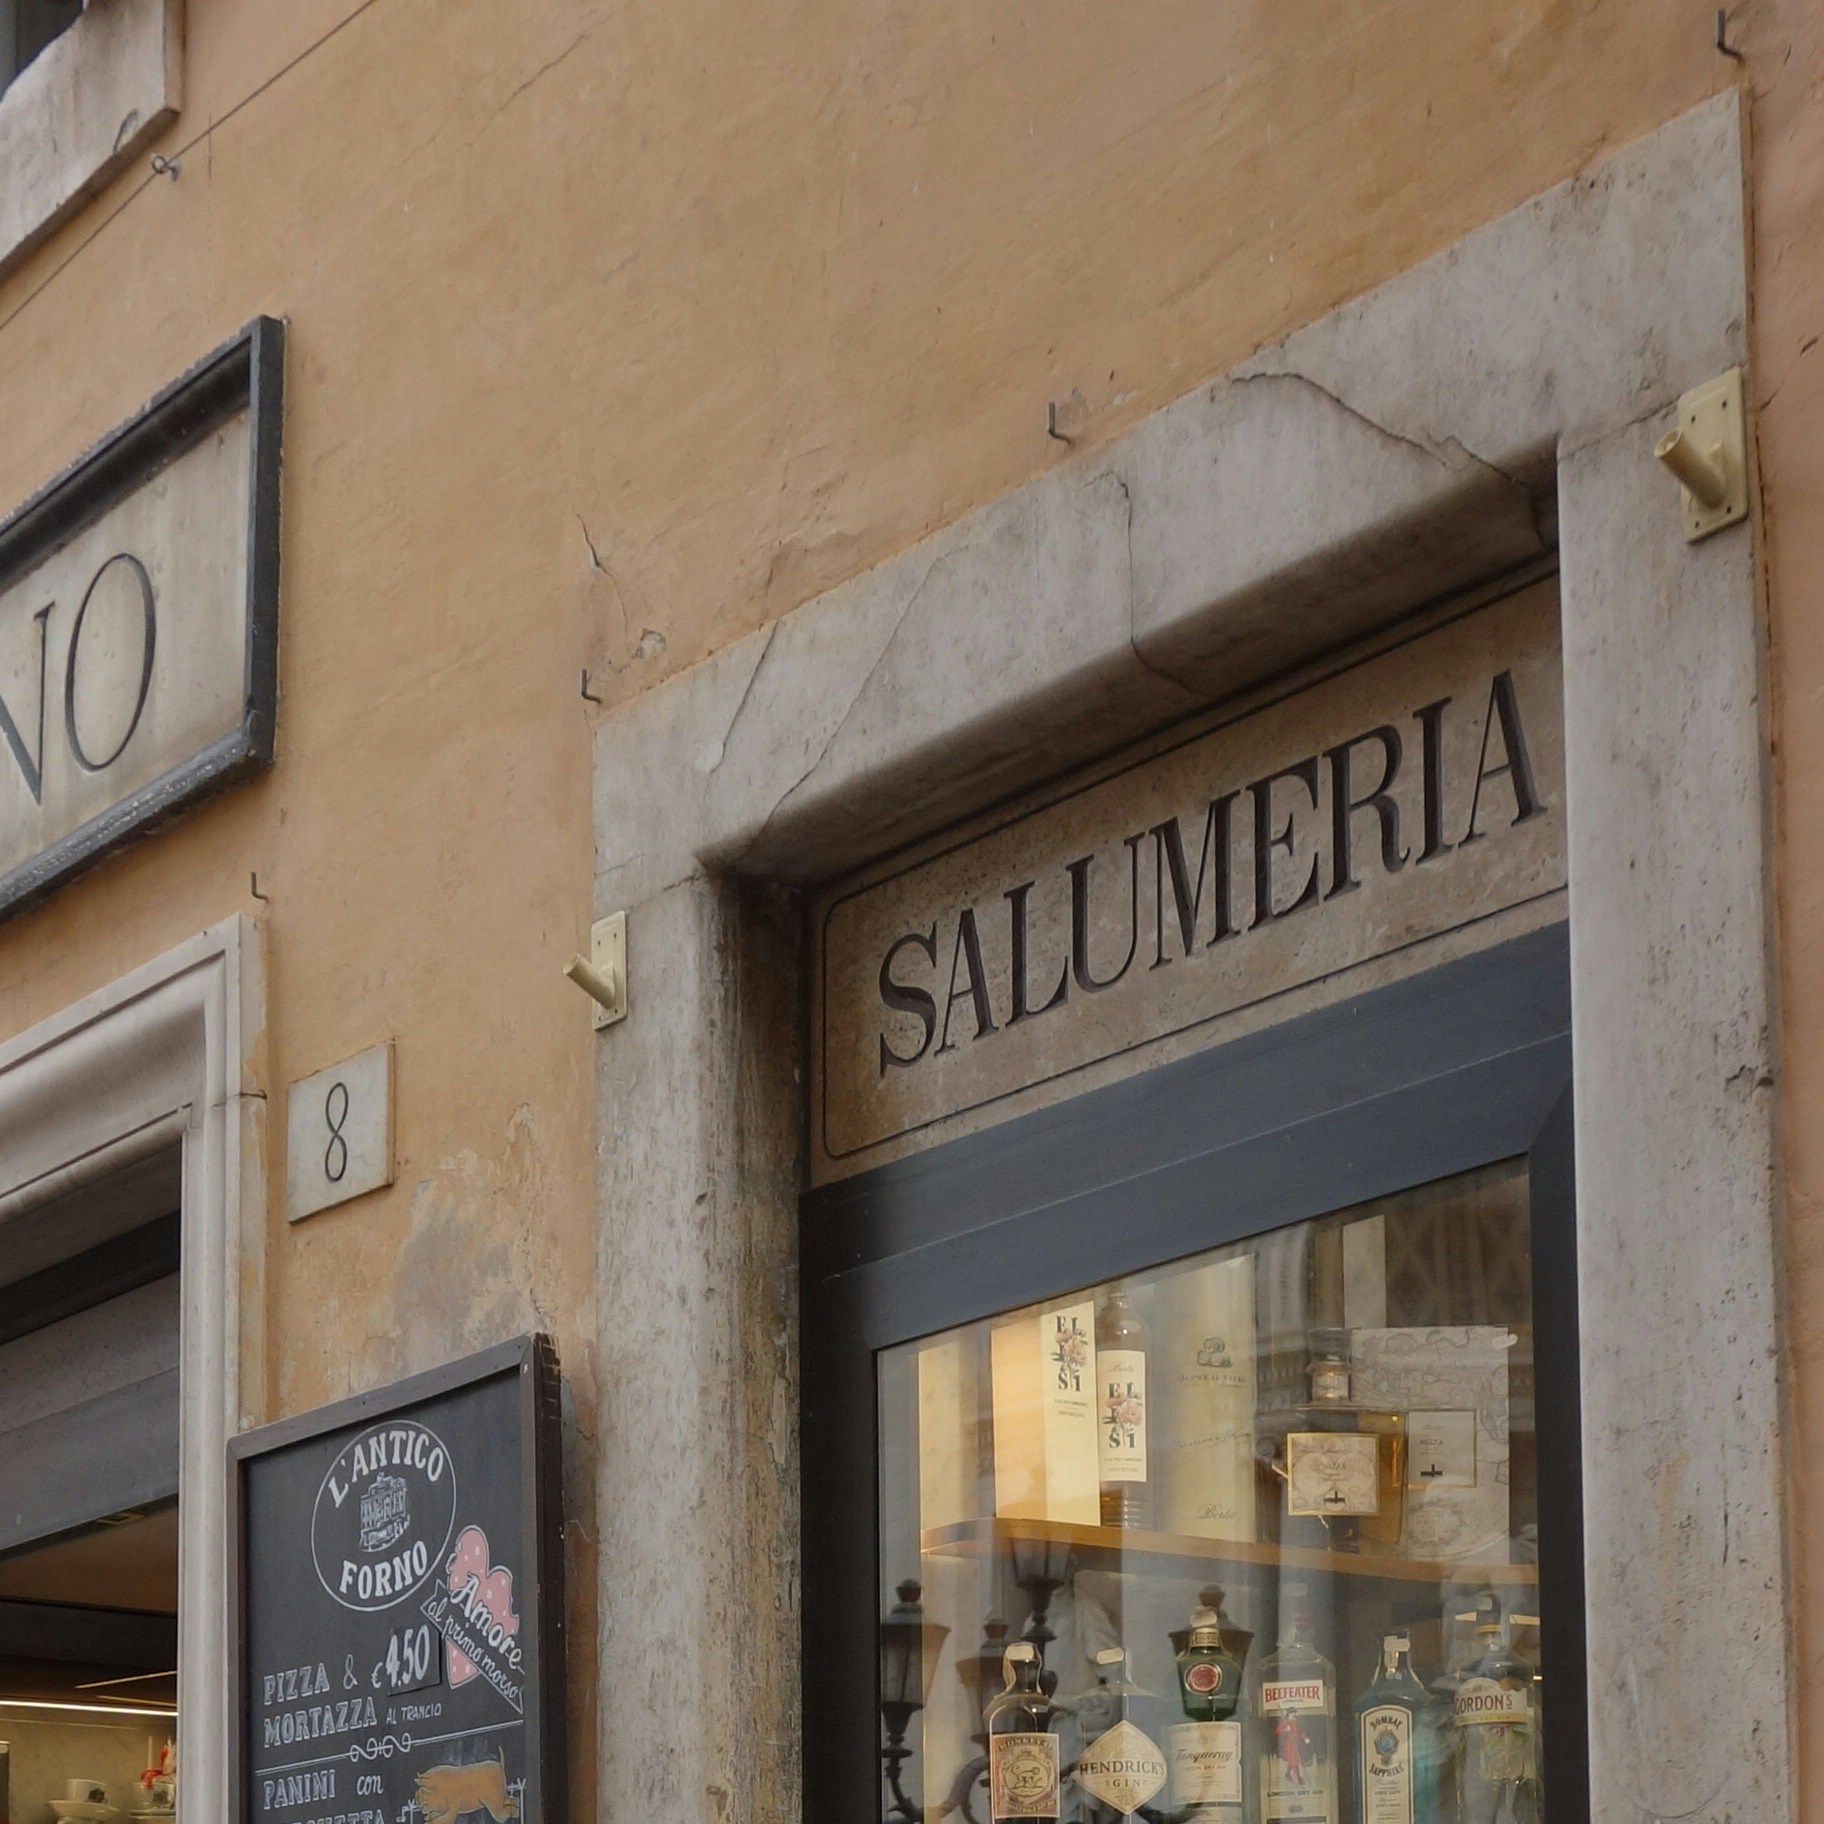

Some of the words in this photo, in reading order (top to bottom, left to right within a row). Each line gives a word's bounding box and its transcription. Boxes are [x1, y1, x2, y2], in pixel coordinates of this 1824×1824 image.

[878, 668, 1549, 1080] SALUMERIA
[324, 1080, 350, 1183] 8
[328, 1428, 445, 1509] L'ANTICO
[339, 1540, 429, 1601] FORNO
[450, 1572, 526, 1676] Amore
[263, 1662, 329, 1705] PIZZA
[342, 1654, 358, 1687] &
[1265, 1685, 1320, 1701] BEEFEATER
[263, 1696, 378, 1748] MORTAZZA
[386, 1707, 398, 1725] AL
[401, 1702, 442, 1723] TRANCIO
[263, 1768, 336, 1810] PANINI
[356, 1774, 384, 1797] con
[1078, 1761, 1165, 1776] HENDRICK'S
